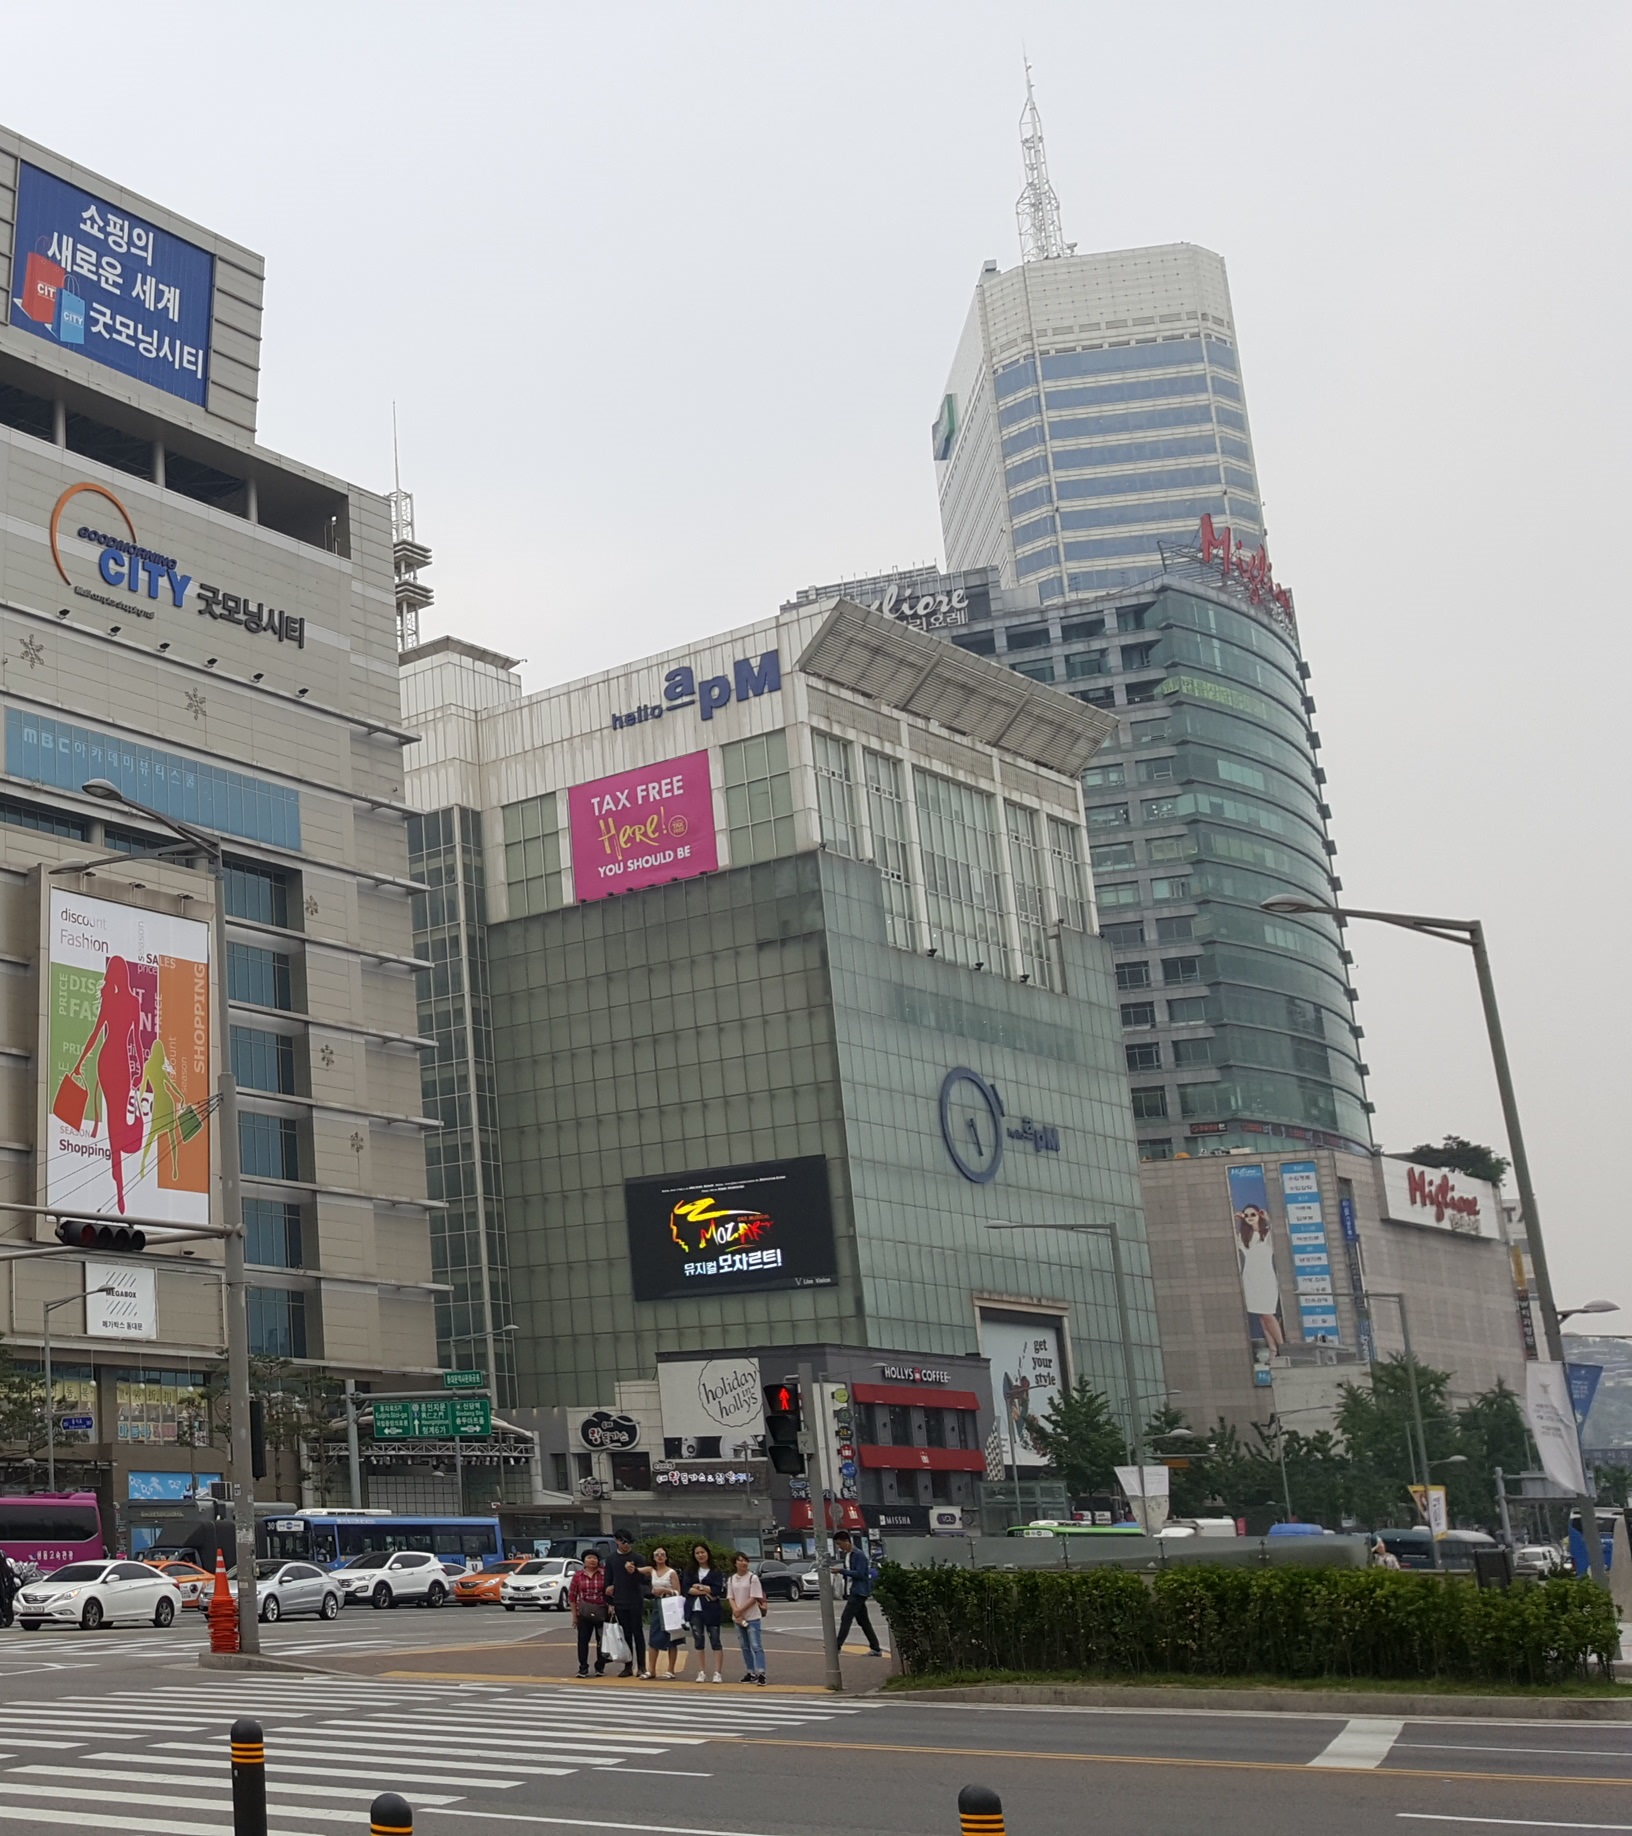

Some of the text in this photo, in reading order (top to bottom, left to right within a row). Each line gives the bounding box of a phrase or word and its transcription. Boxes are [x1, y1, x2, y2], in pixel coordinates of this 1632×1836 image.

[79, 204, 154, 267] 쇼핑의
[47, 231, 180, 323] 새로운 세계
[37, 282, 57, 297] CIT
[63, 311, 84, 326] CITY
[89, 302, 204, 380] 굿모닝시티
[77, 526, 178, 570] GOODMORNING
[99, 548, 192, 608] CITY
[870, 584, 969, 618] liore
[197, 583, 305, 650] 굿모닝시티
[905, 610, 968, 631] 리오레
[612, 649, 782, 731] hello apM
[591, 775, 685, 817] TAX FREE
[598, 845, 691, 879] YOU SHOULD BE
[60, 907, 108, 931] discount
[60, 929, 109, 953] Fashion
[137, 964, 158, 976] price
[146, 953, 176, 969] SALES
[58, 973, 68, 1015] PRICE
[193, 963, 206, 1074] SHOPPING
[59, 1139, 112, 1161] Shopping
[684, 1248, 783, 1277] 뮤지컬 모차르트!
[105, 1289, 137, 1299] MEGABOX
[101, 1320, 143, 1331] 메가박스 동대문
[1033, 1339, 1048, 1354] get
[885, 1366, 949, 1383] HOLLYS COFFEE
[1032, 1357, 1053, 1371] your
[702, 1370, 757, 1405] holiday
[1035, 1372, 1056, 1386] style
[885, 1516, 911, 1525] MISSHA
